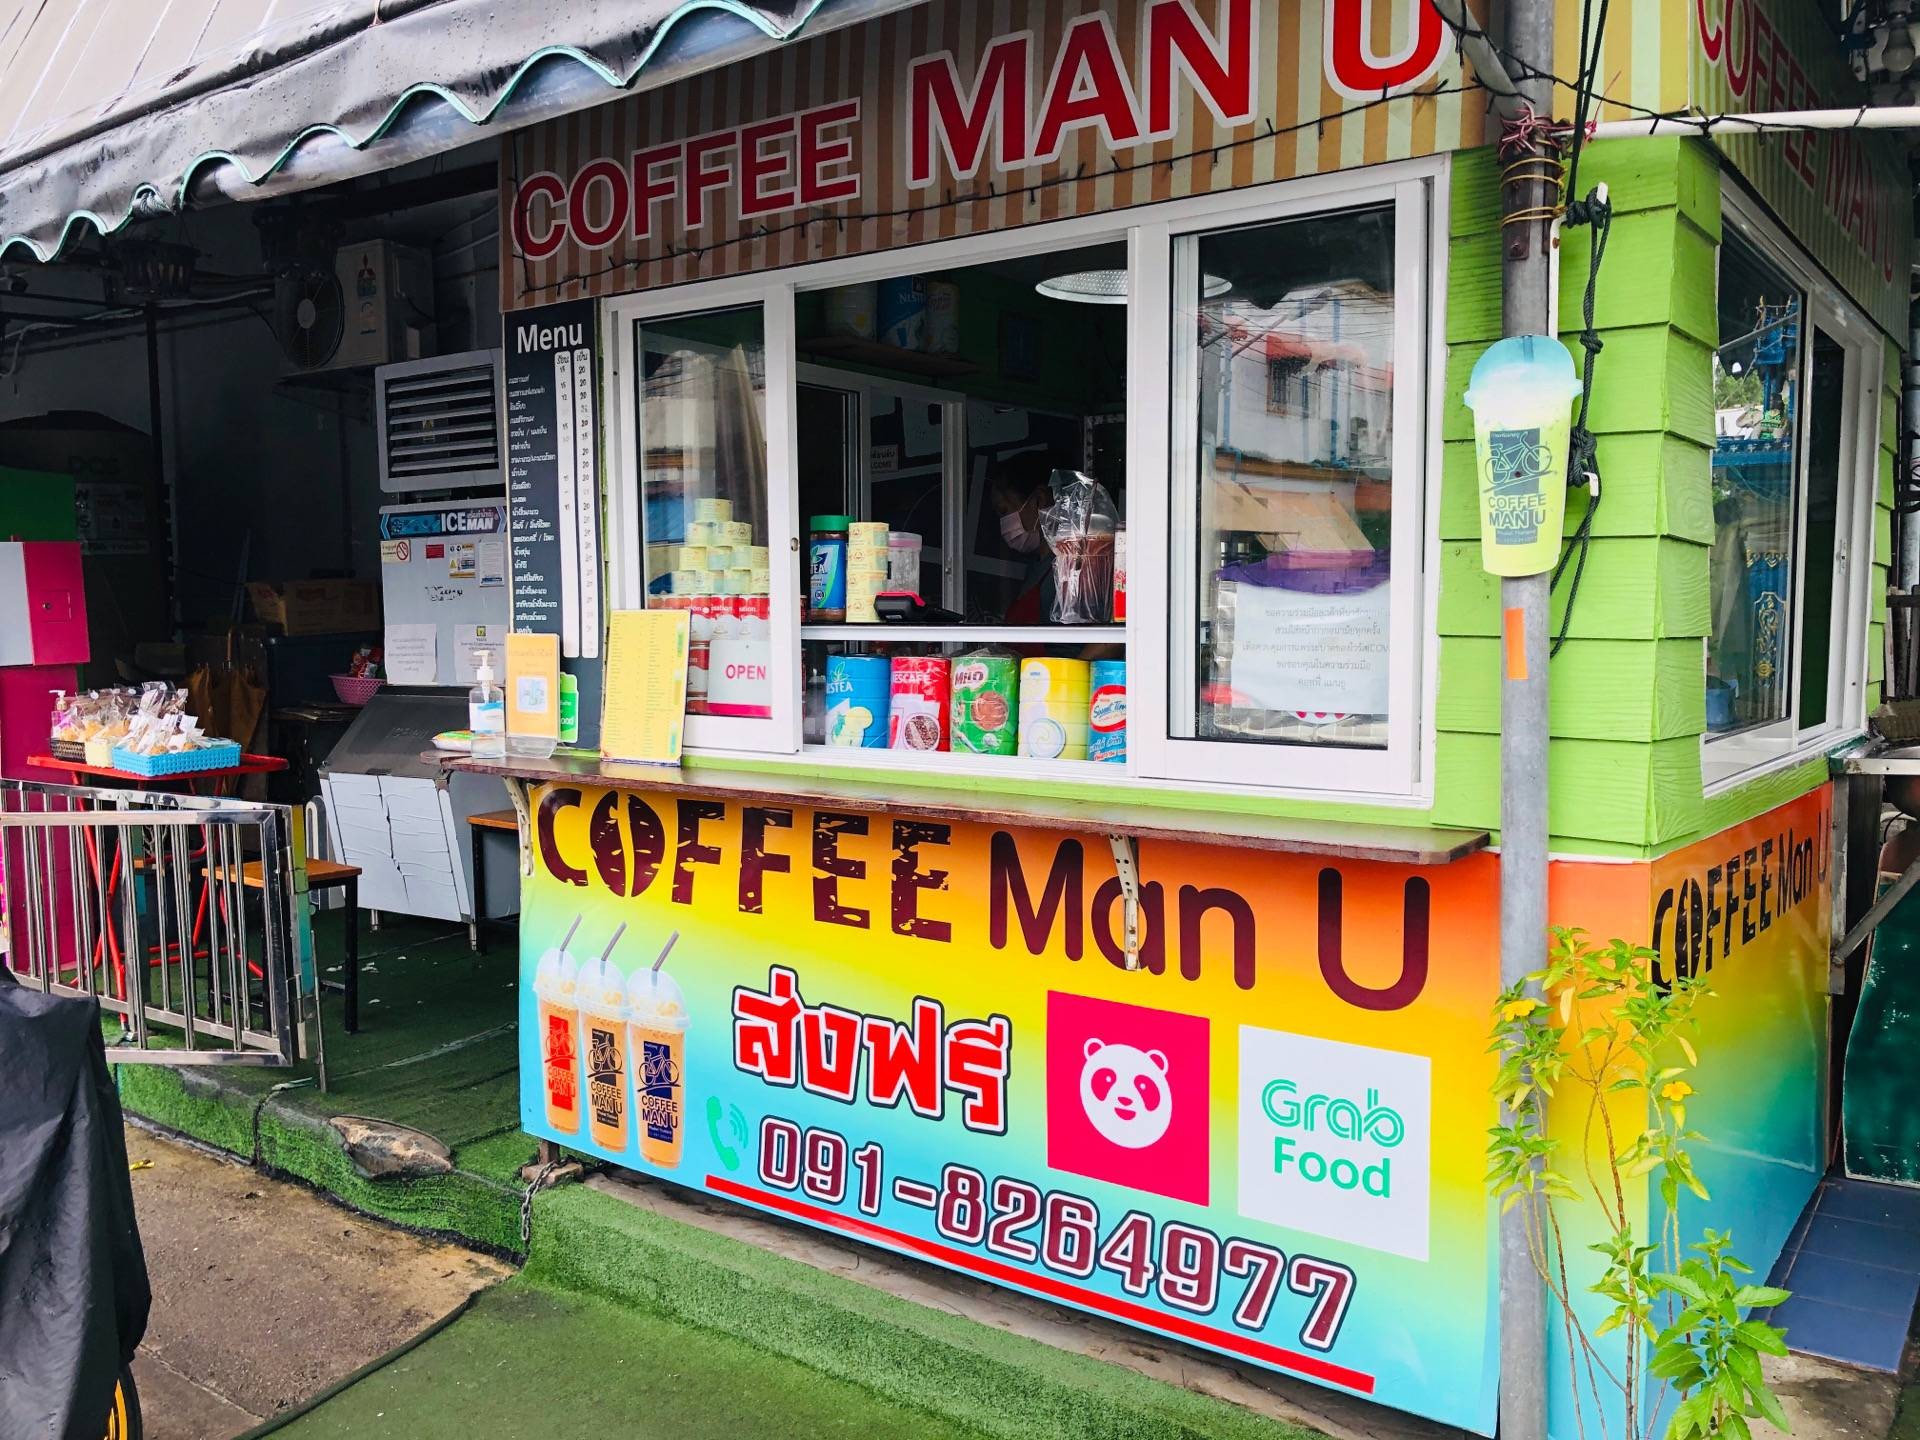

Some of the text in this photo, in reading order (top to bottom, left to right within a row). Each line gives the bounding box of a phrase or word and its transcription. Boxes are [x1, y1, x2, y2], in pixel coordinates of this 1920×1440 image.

[513, 0, 1452, 261] COFFEE MAN U
[517, 323, 583, 354] Menu
[1488, 493, 1547, 510] COFFEE
[441, 512, 494, 532] ICE MAN
[1489, 508, 1547, 530] MAN U
[725, 664, 767, 680] OPEN
[827, 681, 853, 694] ESTEA
[537, 788, 1431, 1012] COFFEE Man U
[1651, 838, 1774, 998] COFFEE
[1777, 827, 1813, 918] Man
[732, 964, 1012, 1136] ส่งฟรี
[590, 1081, 622, 1099] COFFEE
[591, 1094, 614, 1115] MAN
[641, 1095, 678, 1113] COFFEE
[1262, 1079, 1405, 1149] Grab
[642, 1108, 668, 1127] MAN
[1274, 1137, 1391, 1199] Food
[758, 1115, 1356, 1352] 091-8264977
